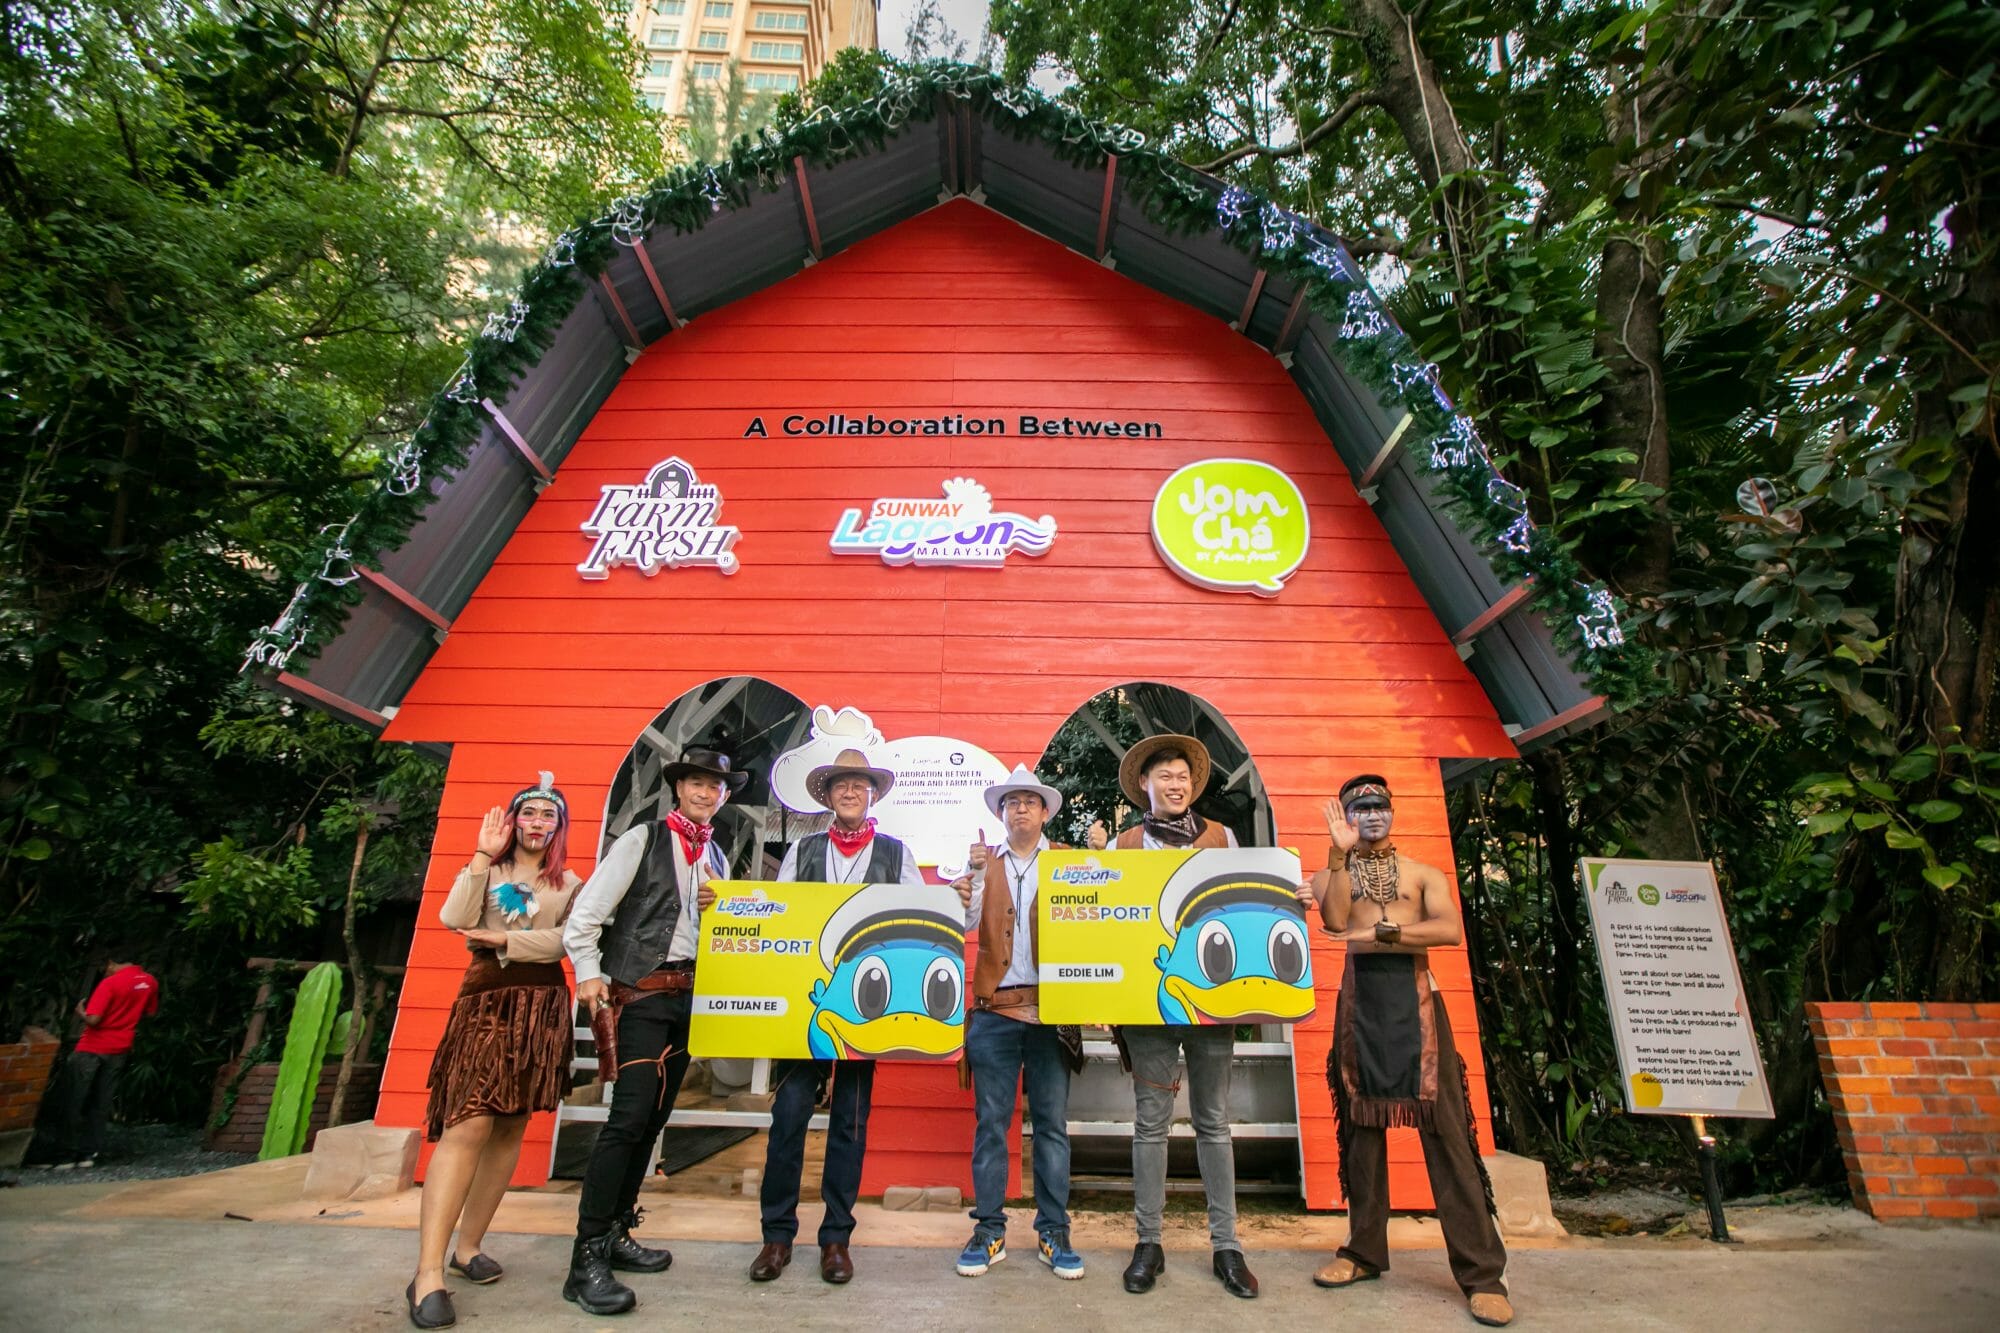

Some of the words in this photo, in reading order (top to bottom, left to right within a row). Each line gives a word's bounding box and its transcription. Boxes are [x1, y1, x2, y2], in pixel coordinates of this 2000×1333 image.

[744, 417, 768, 437] A
[782, 414, 1005, 437] Collaboration
[1018, 414, 1163, 438] Between
[1179, 476, 1289, 517] Jom
[874, 502, 963, 517] SUNWAY
[834, 513, 1013, 555] Lagoon
[916, 547, 1002, 557] MALAYSIA
[945, 770, 981, 778] BETWEEN
[1052, 869, 1110, 884] Lagoon
[1050, 891, 1098, 904] annual
[1665, 892, 1700, 903] Lagoon
[717, 900, 775, 916] Lagoon
[1051, 906, 1152, 921] PASSPORT
[712, 924, 761, 937] annual
[1617, 923, 1632, 931] first
[1634, 925, 1642, 933] of
[711, 937, 812, 953] PASSPORT
[1634, 951, 1653, 959] Fresh
[1058, 968, 1092, 977] EDDIE
[1095, 968, 1114, 977] LIM
[1620, 969, 1639, 977] Learn
[1706, 981, 1725, 989] about
[708, 1000, 727, 1010] LOI
[731, 1001, 761, 1010] TUAN
[764, 1001, 777, 1010] EE
[1670, 1008, 1689, 1016] Ladies
[1645, 1017, 1664, 1025] fresh
[1687, 1019, 1719, 1027] produced
[1655, 1027, 1671, 1035] little
[1635, 1045, 1652, 1054] Then
[1652, 1046, 1669, 1054] head
[1688, 1047, 1697, 1055] to
[1728, 1049, 1741, 1057] and
[1637, 1056, 1663, 1064] explore
[1679, 1057, 1697, 1065] Farm
[1699, 1058, 1718, 1066] Fresh
[1640, 1066, 1671, 1075] products
[1742, 1069, 1753, 1077] the
[1641, 1076, 1669, 1084] delicious
[1672, 1077, 1685, 1085] and
[1687, 1077, 1704, 1086] tasty
[1705, 1078, 1722, 1086] boba
